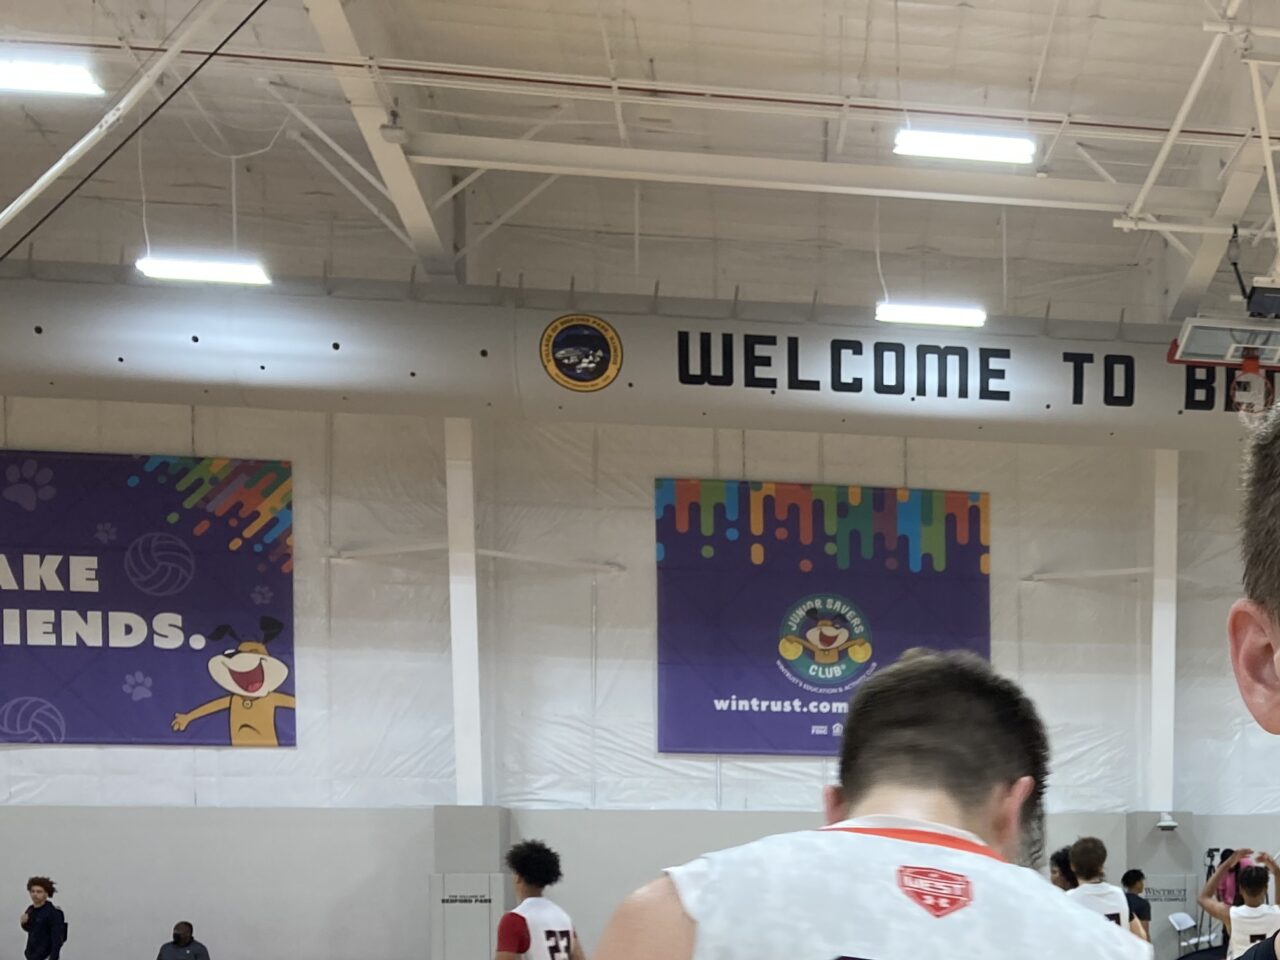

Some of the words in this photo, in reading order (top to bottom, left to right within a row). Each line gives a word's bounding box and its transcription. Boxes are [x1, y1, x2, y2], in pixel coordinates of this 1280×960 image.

[677, 330, 1011, 402] WELCOME
[1063, 352, 1135, 407] TO
[3, 608, 206, 650] IENDS.
[788, 599, 822, 631] JUNIOR
[826, 599, 864, 633] SAVERS
[713, 694, 849, 713] wintrust.com
